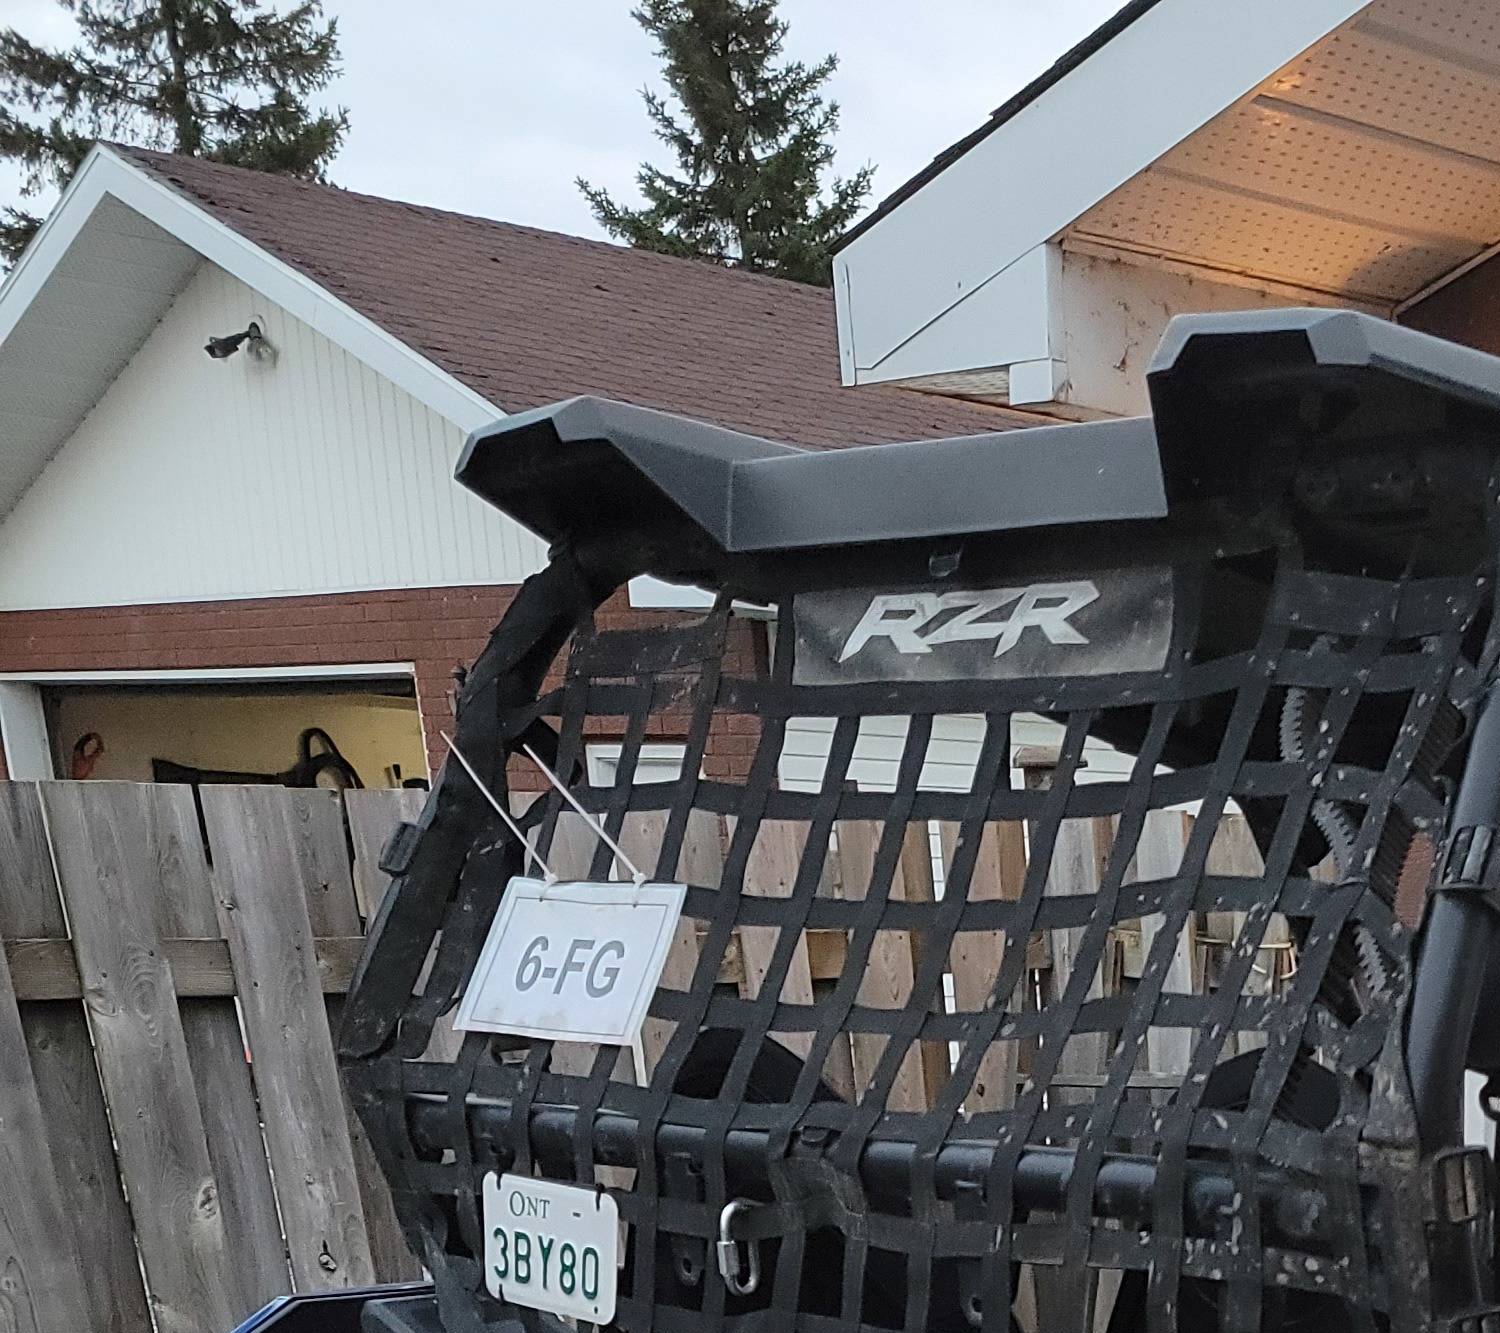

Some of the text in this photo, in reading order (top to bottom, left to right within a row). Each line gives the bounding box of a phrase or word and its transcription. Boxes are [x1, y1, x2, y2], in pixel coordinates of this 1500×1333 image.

[839, 581, 1101, 662] RZR
[514, 935, 626, 999] 6-FG
[493, 1227, 599, 1300] 3BY80
